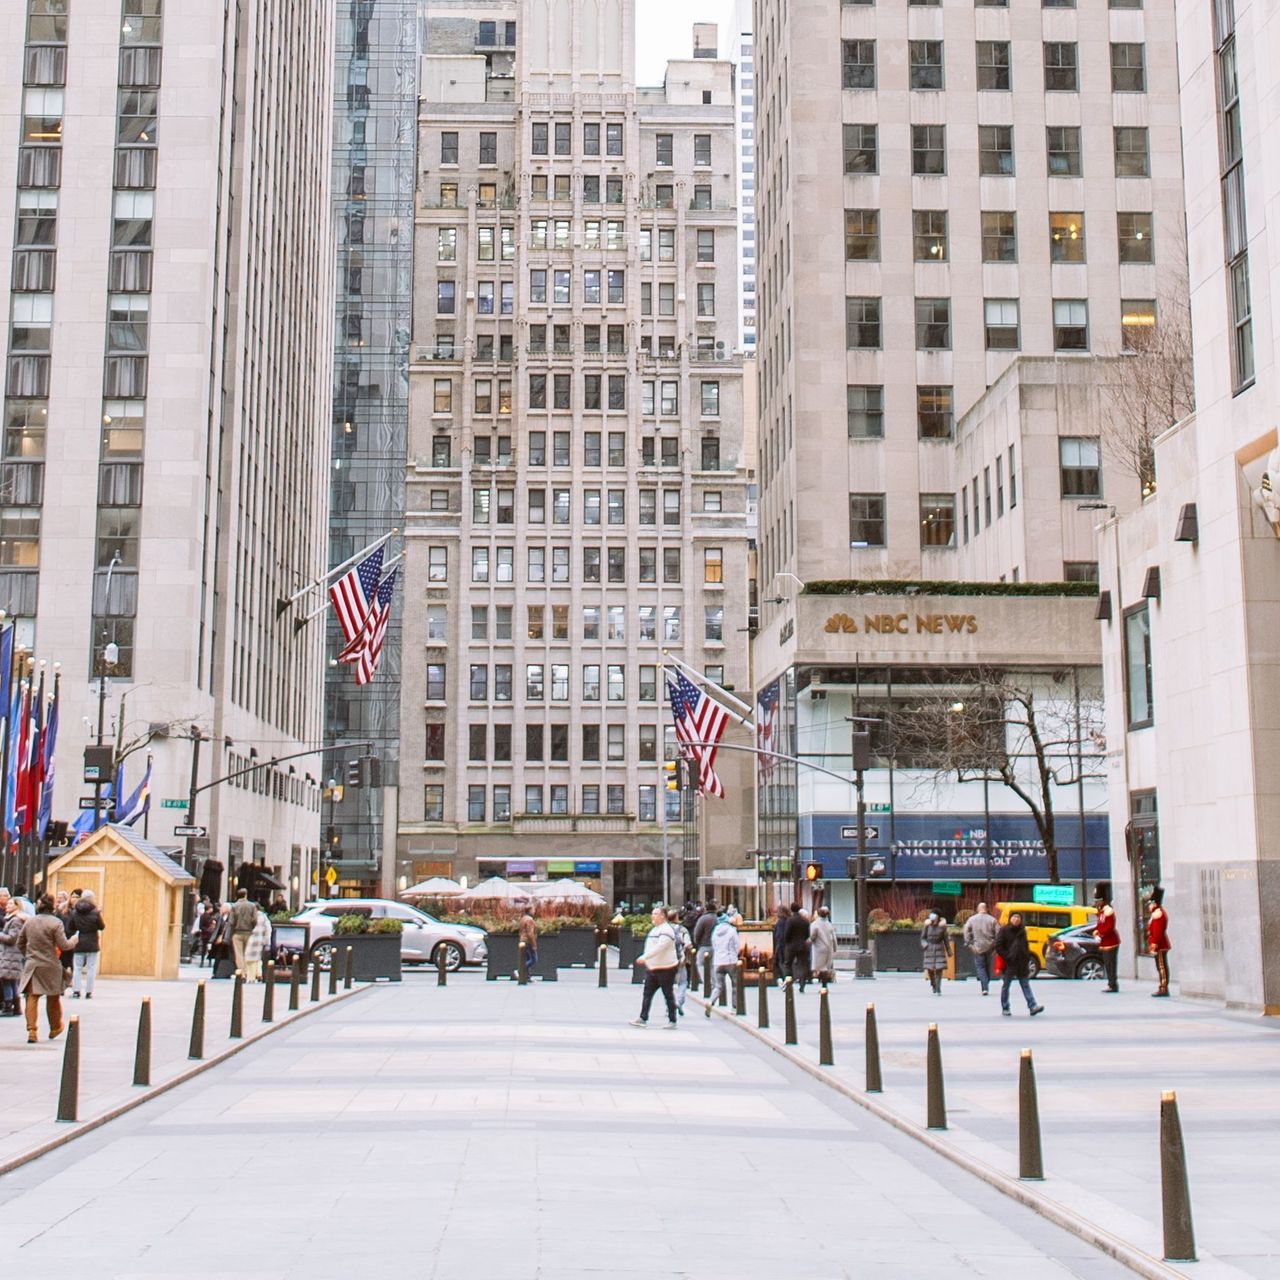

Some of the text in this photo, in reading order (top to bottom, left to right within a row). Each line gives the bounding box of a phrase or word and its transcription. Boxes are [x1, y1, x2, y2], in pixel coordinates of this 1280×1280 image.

[864, 614, 978, 634] NBC NEWS
[897, 840, 1047, 857] NIGHTLY NEWS
[951, 857, 986, 866] LESTER
